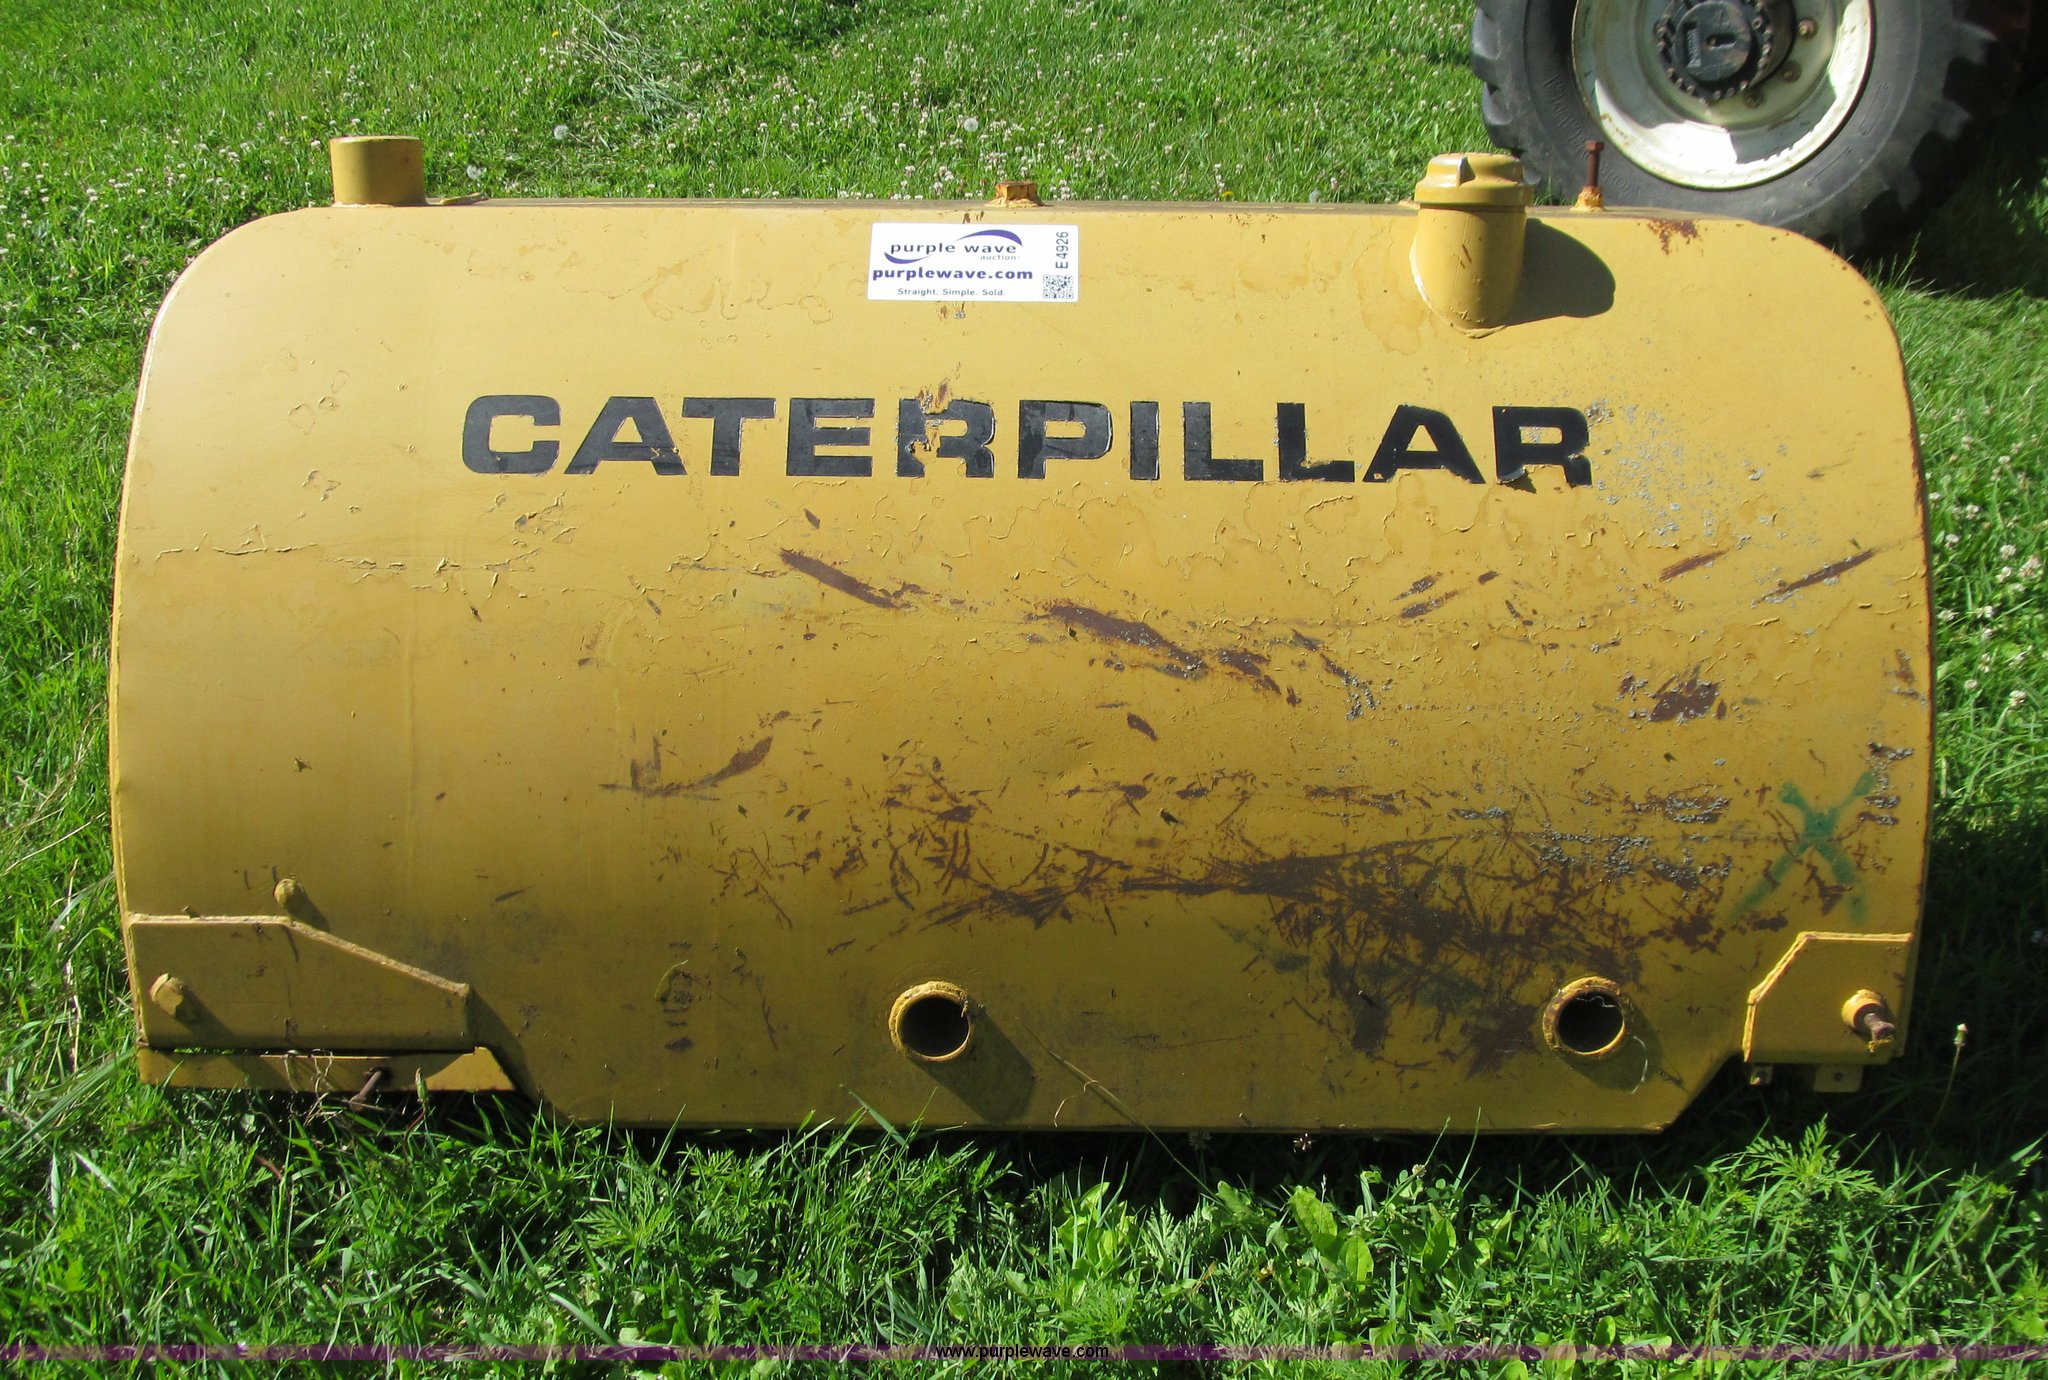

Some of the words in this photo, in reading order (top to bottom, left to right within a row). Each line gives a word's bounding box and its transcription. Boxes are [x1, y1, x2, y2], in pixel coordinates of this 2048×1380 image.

[890, 241, 956, 256] purple
[964, 243, 1017, 254] wave
[872, 266, 1034, 282] purplewave.com
[897, 288, 939, 297] Straight.
[942, 288, 979, 297] Simple.
[982, 288, 1006, 297] Sold.
[462, 395, 1592, 490] CATERPILLAR
